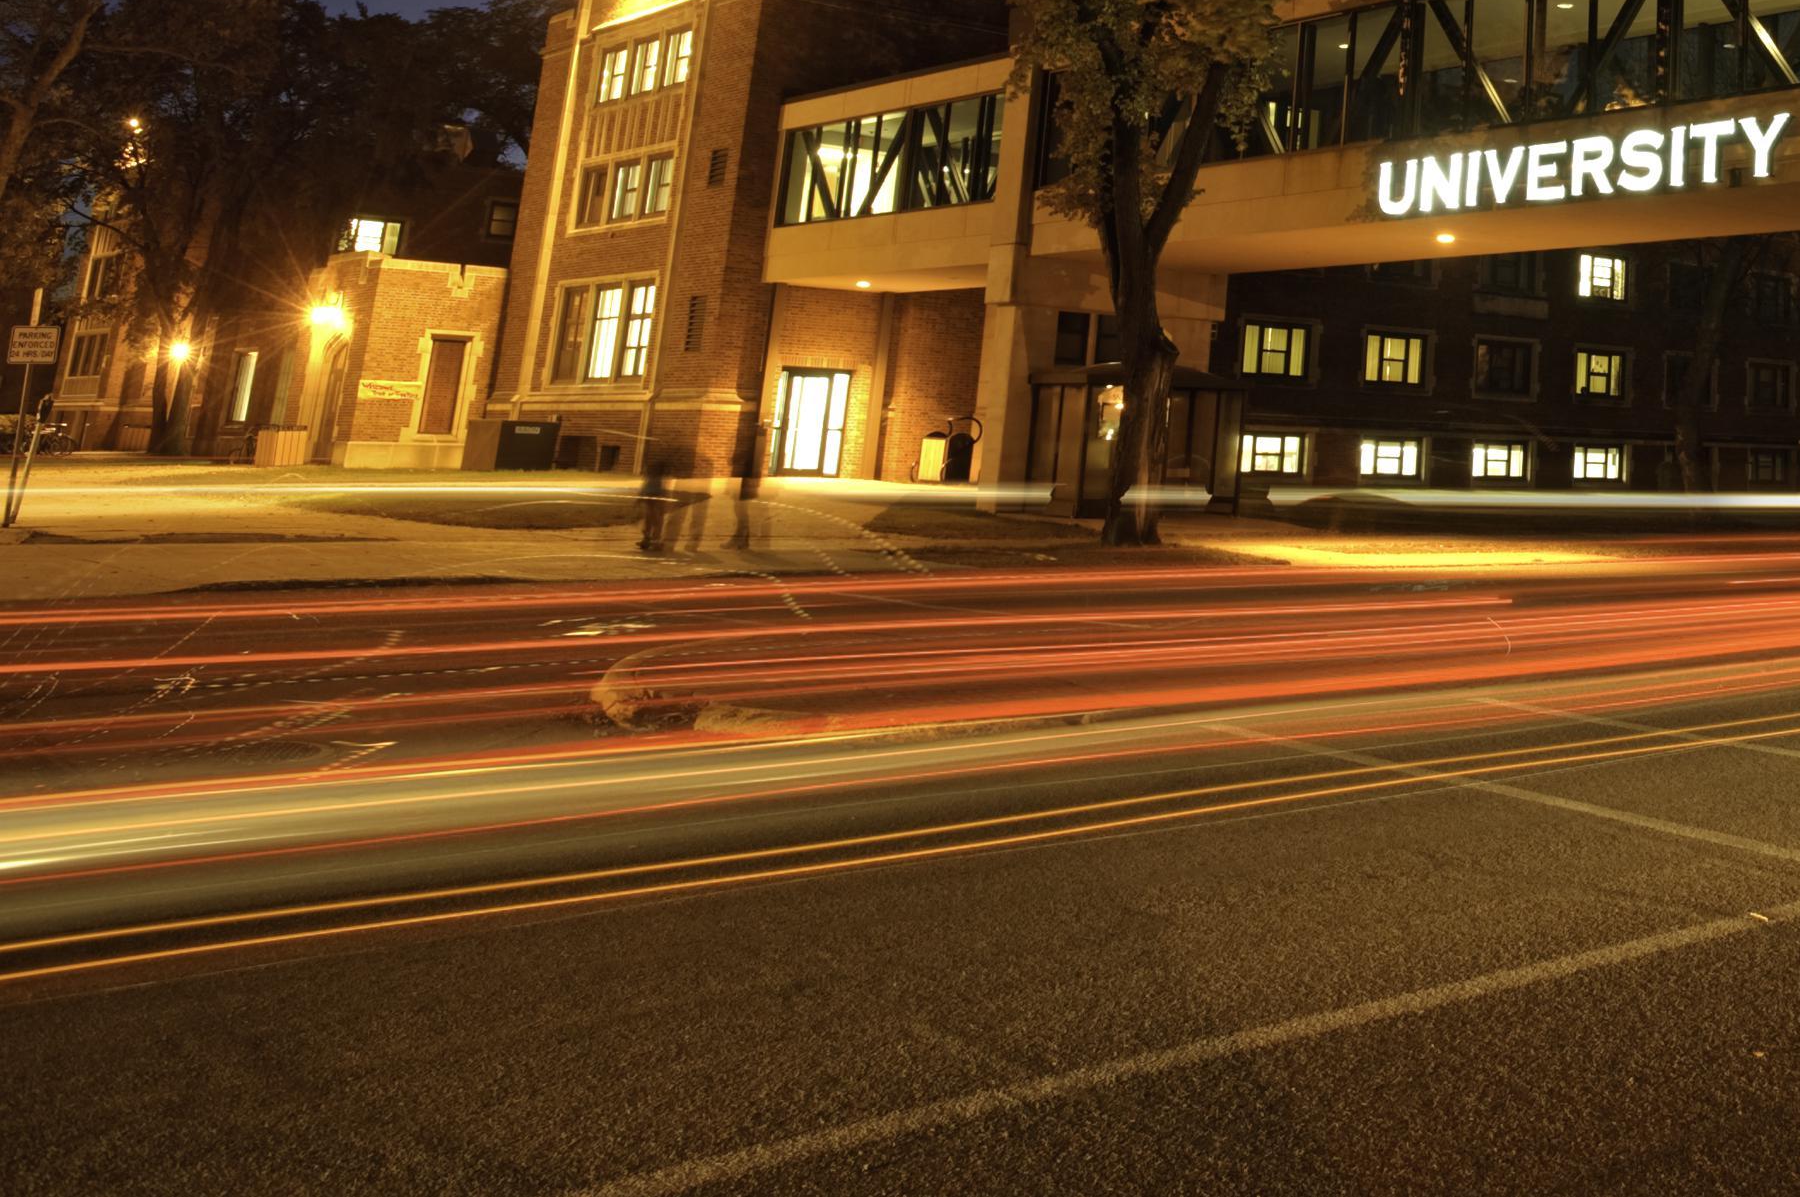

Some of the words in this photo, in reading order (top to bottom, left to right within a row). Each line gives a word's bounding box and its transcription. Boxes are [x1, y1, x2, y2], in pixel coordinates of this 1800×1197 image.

[1377, 112, 1791, 216] UNIVERSITY
[18, 332, 52, 340] PARKING
[12, 340, 55, 349] ENFORCED
